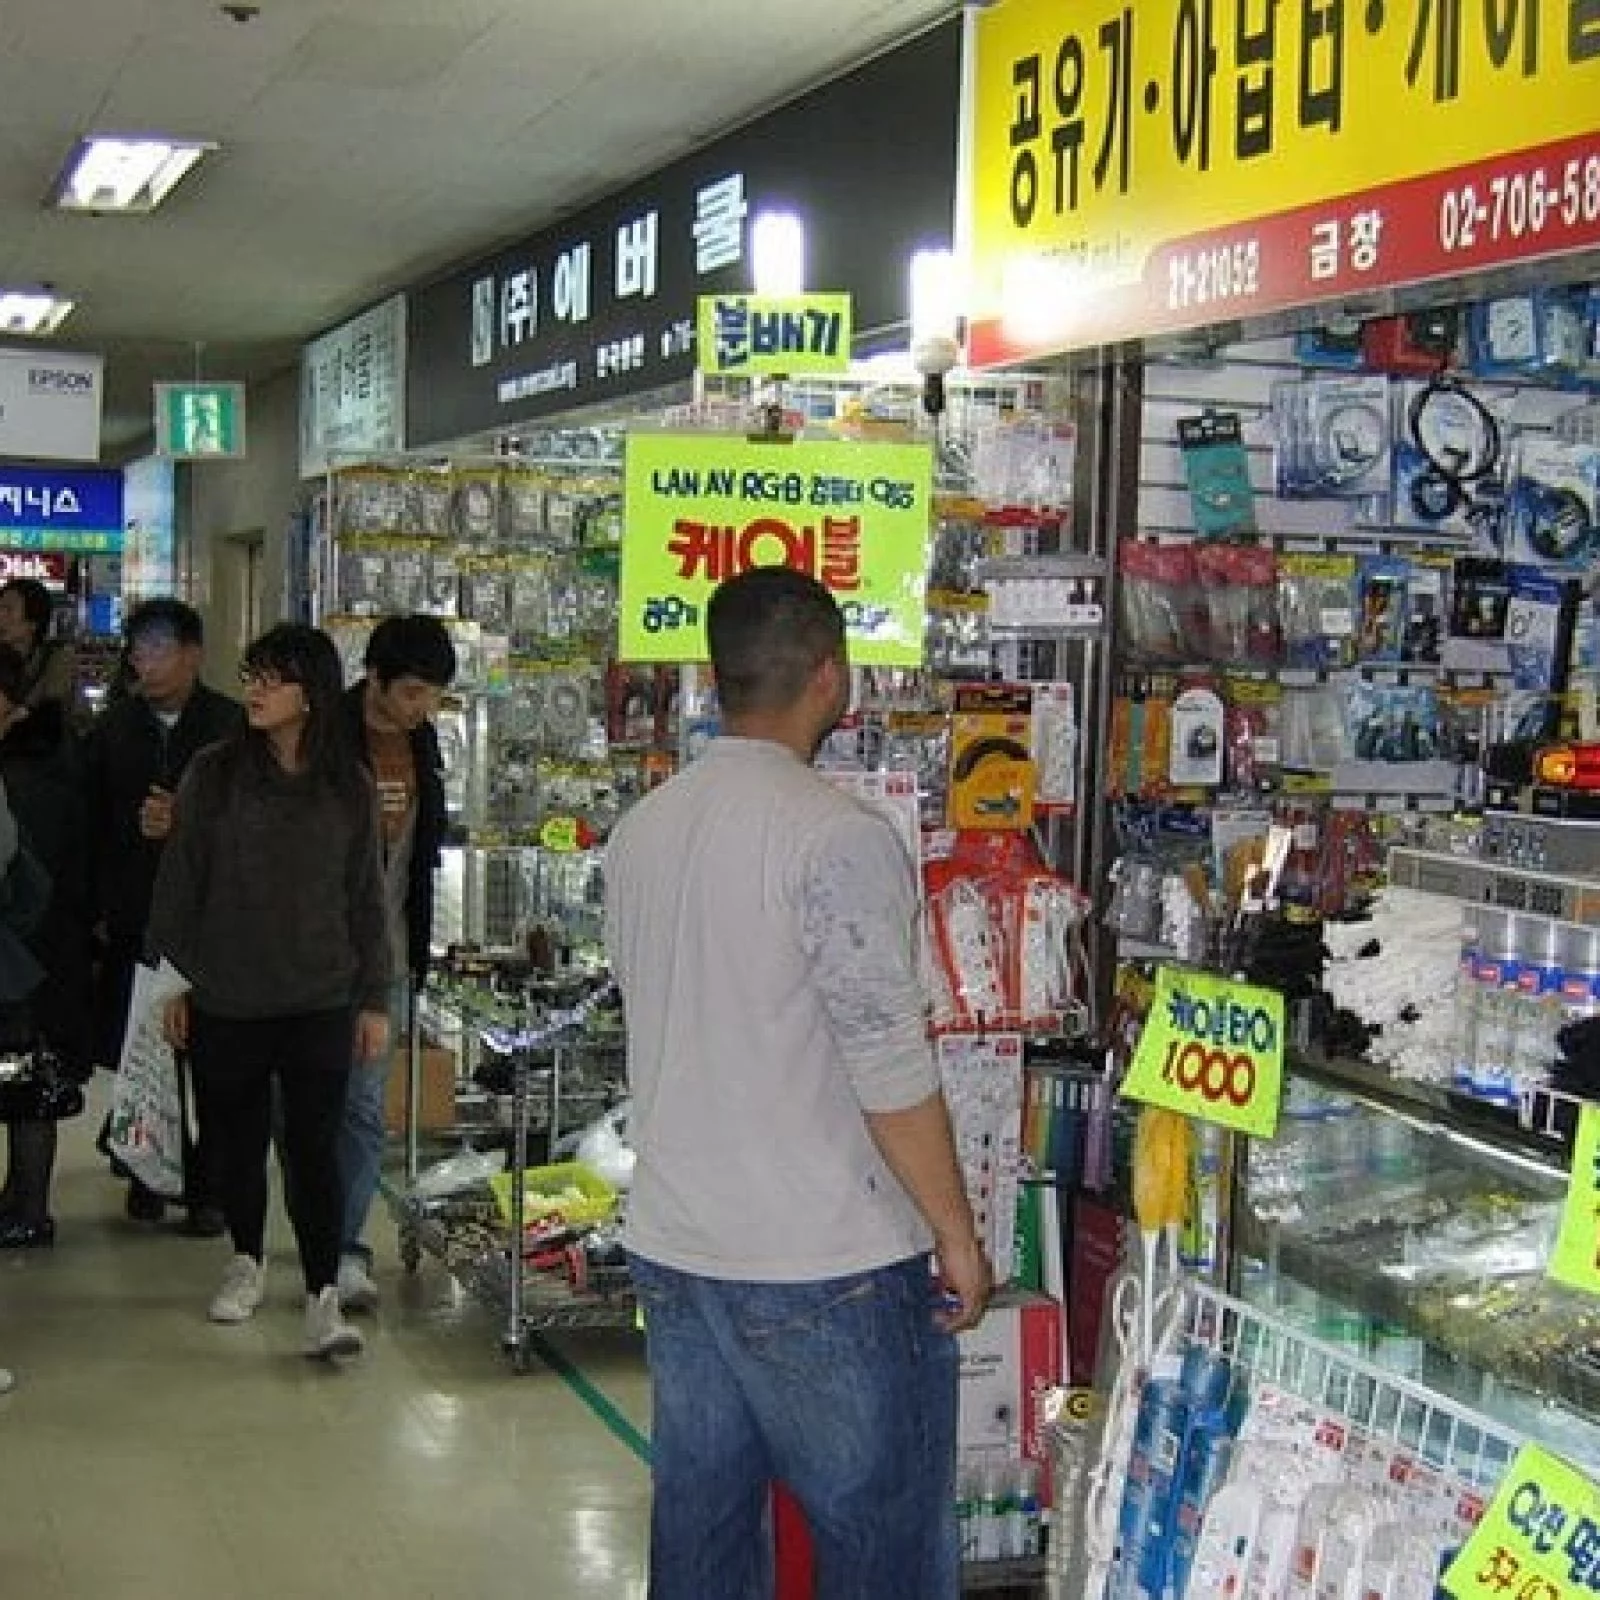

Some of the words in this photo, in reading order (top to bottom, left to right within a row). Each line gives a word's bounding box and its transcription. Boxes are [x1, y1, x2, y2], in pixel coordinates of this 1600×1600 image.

[651, 468, 700, 496] LAN
[704, 468, 737, 495] AV
[742, 471, 803, 505] RGB
[667, 514, 862, 591] 케이블
